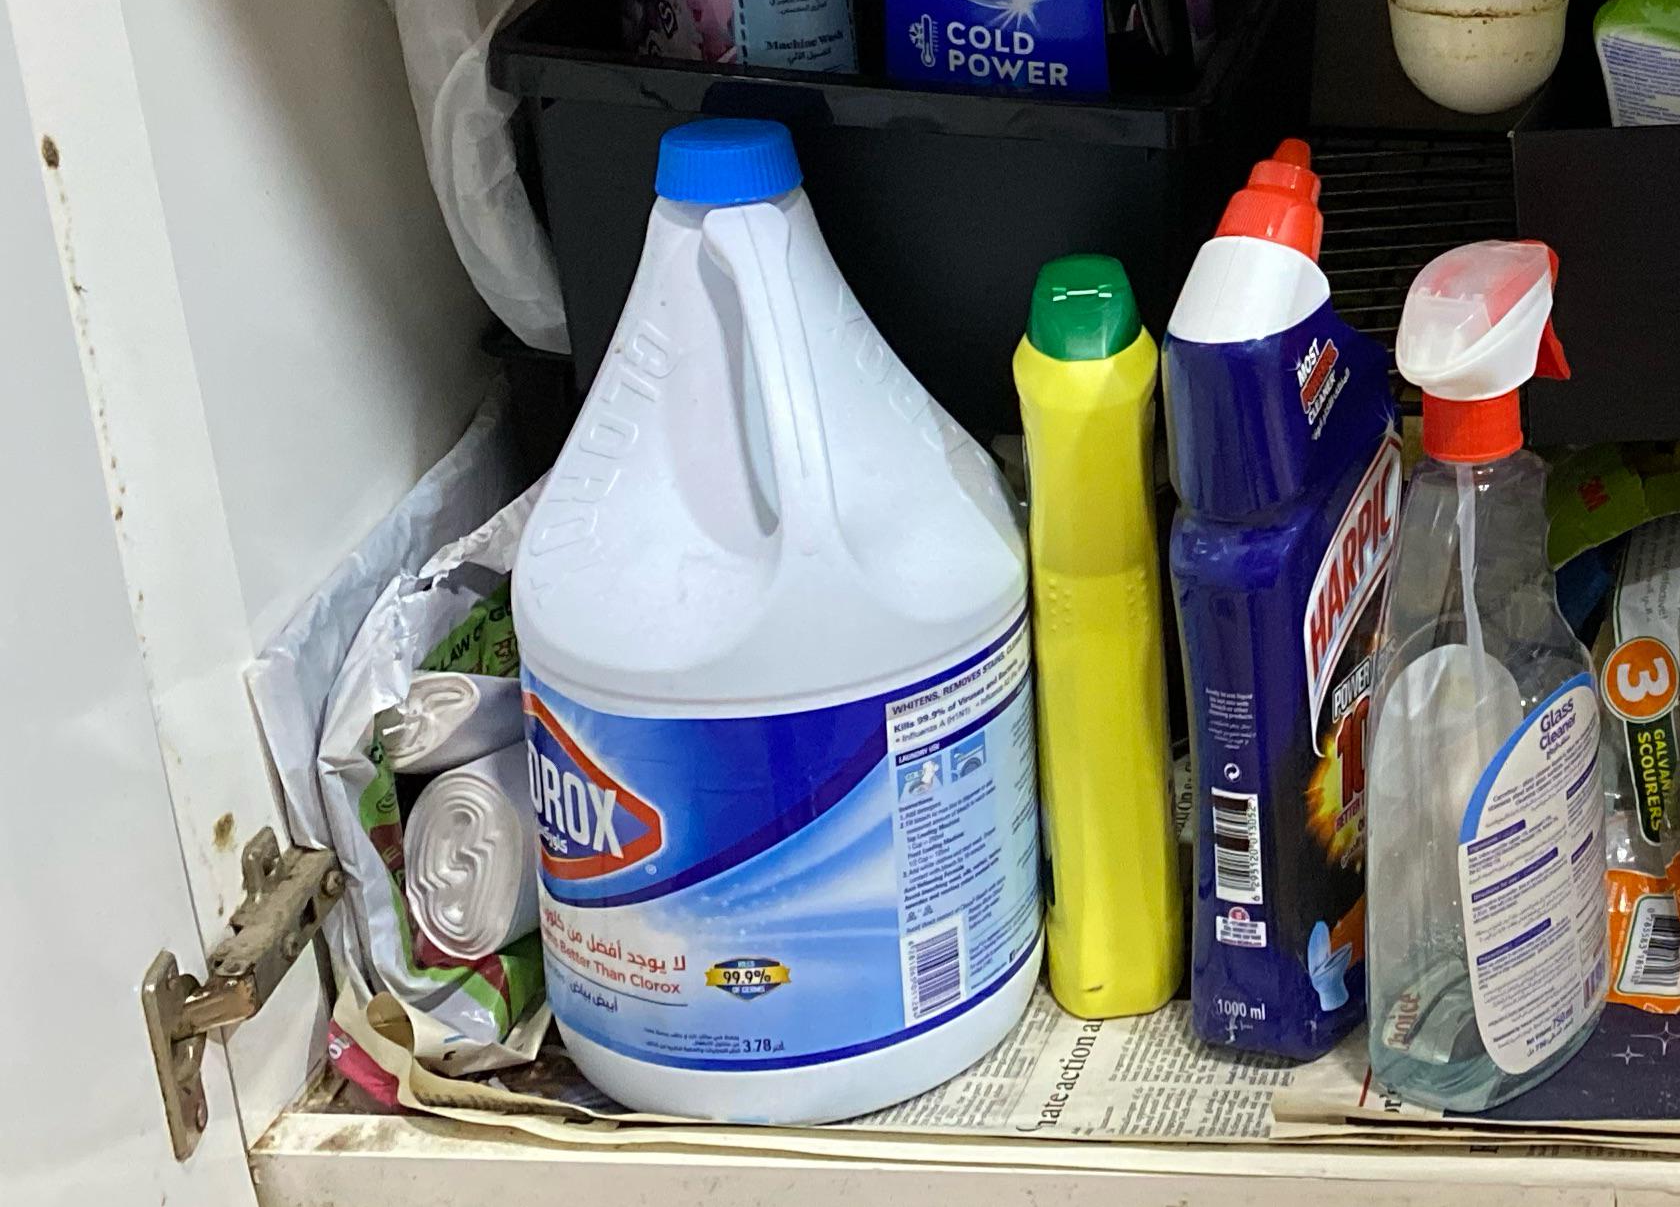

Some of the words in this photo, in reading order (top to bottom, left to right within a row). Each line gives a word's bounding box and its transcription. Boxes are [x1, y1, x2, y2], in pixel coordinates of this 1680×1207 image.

[766, 38, 817, 50] Machine
[947, 22, 1034, 55] COLD
[948, 49, 1068, 86] POWER
[1297, 337, 1320, 387] MOST
[1310, 458, 1393, 684] HARPIC
[942, 669, 981, 695] REMOVES
[1334, 660, 1371, 720] POWER
[1617, 657, 1669, 703] 3
[894, 722, 914, 734] Kills
[917, 707, 945, 725] 99.9%
[947, 701, 956, 712] of
[1539, 712, 1577, 751] Cleaner
[1540, 697, 1574, 733] Glass
[1637, 731, 1663, 832] SCOURERS
[527, 739, 624, 859] OROX
[1250, 894, 1261, 903] 6
[567, 925, 582, 942] من
[586, 933, 622, 960] أفضل
[560, 939, 590, 968] Better
[593, 960, 626, 983] Than
[629, 973, 680, 994] Clorox
[627, 952, 666, 975] يوجد
[673, 955, 686, 971] لا
[723, 969, 772, 984] 99.9%
[1217, 998, 1247, 1017] 1000
[1250, 1002, 1266, 1021] ml
[743, 1039, 772, 1054] 3.78
[1056, 1035, 1097, 1091] action
